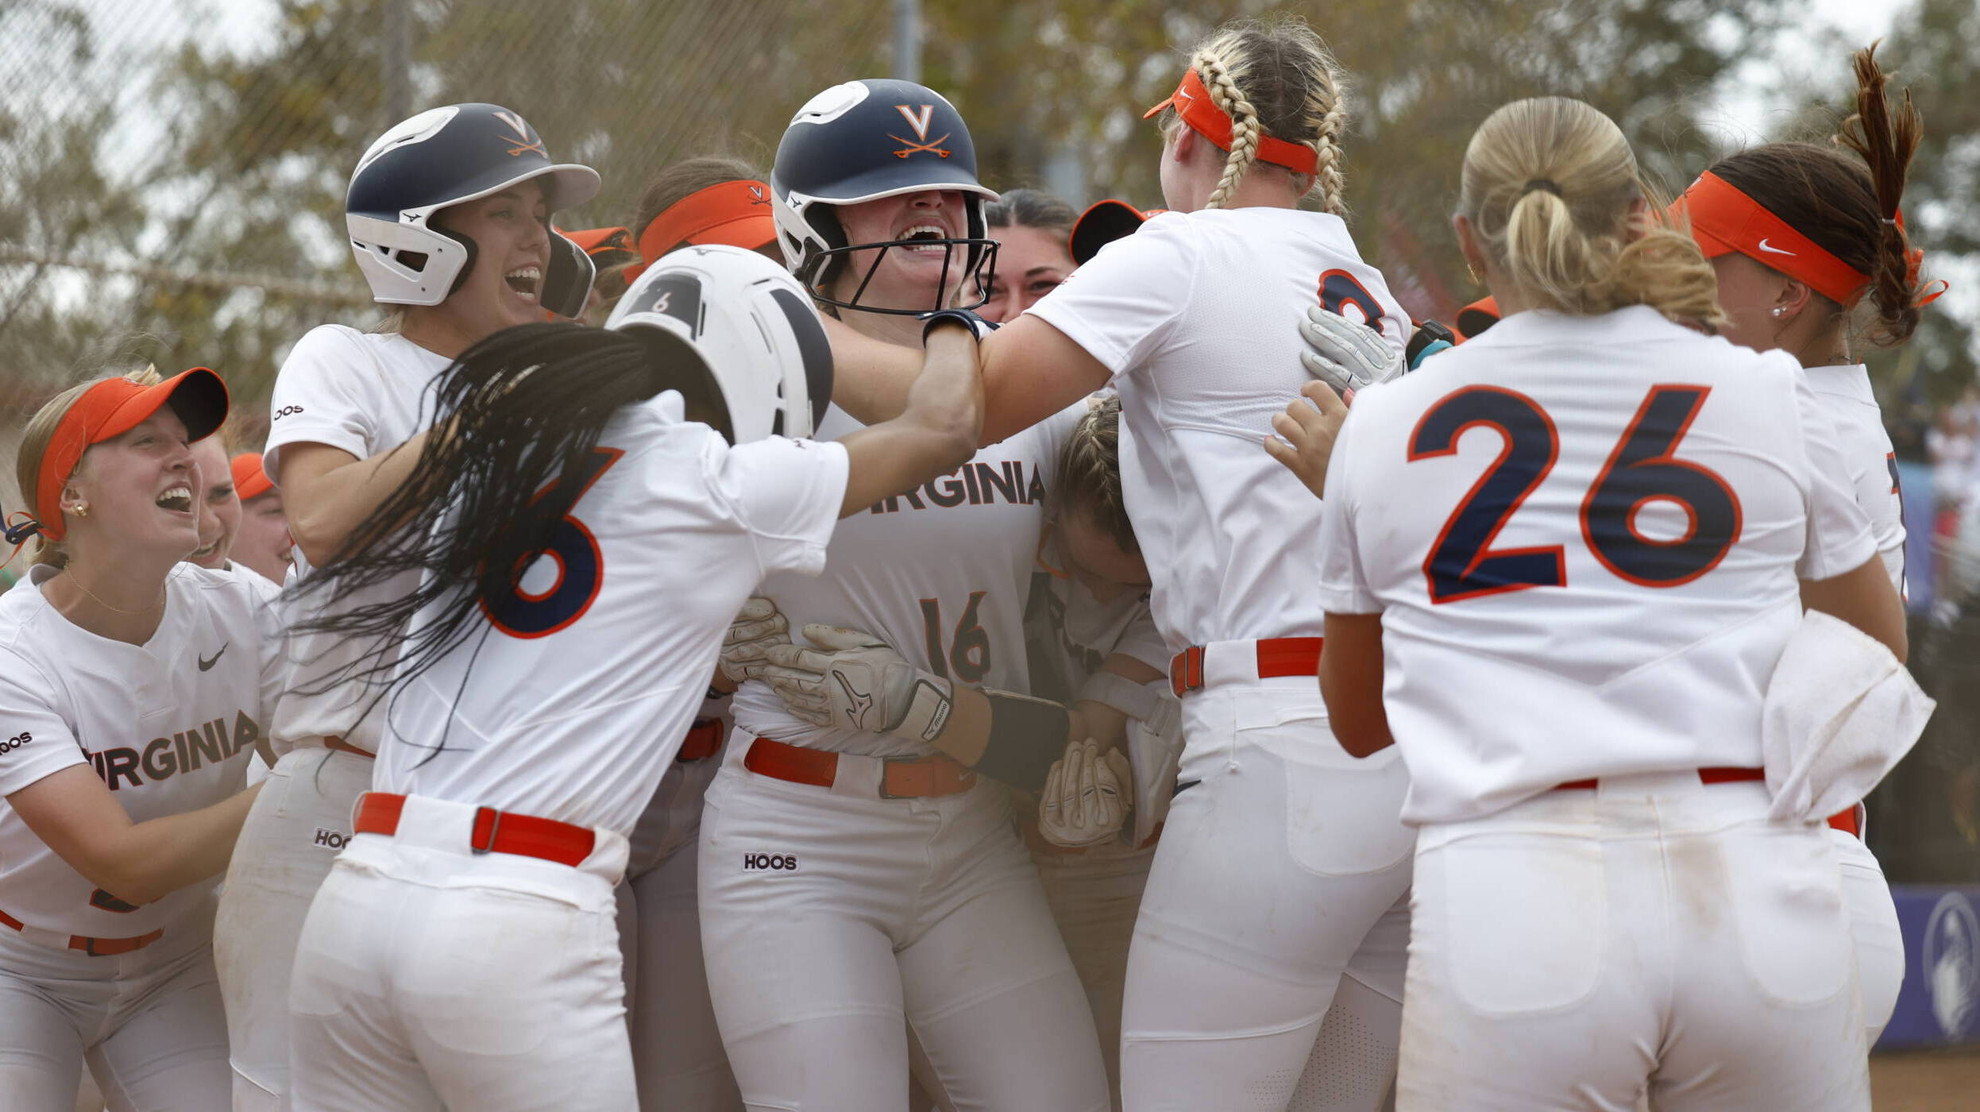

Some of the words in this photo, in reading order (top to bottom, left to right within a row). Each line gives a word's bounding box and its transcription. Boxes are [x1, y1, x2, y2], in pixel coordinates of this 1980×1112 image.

[893, 104, 934, 142] V
[651, 291, 672, 313] 6
[1407, 383, 1743, 605] 26
[478, 446, 626, 639] 6
[918, 591, 991, 683] 16
[81, 709, 258, 791] IRGINIA
[744, 854, 797, 870] HOOS
